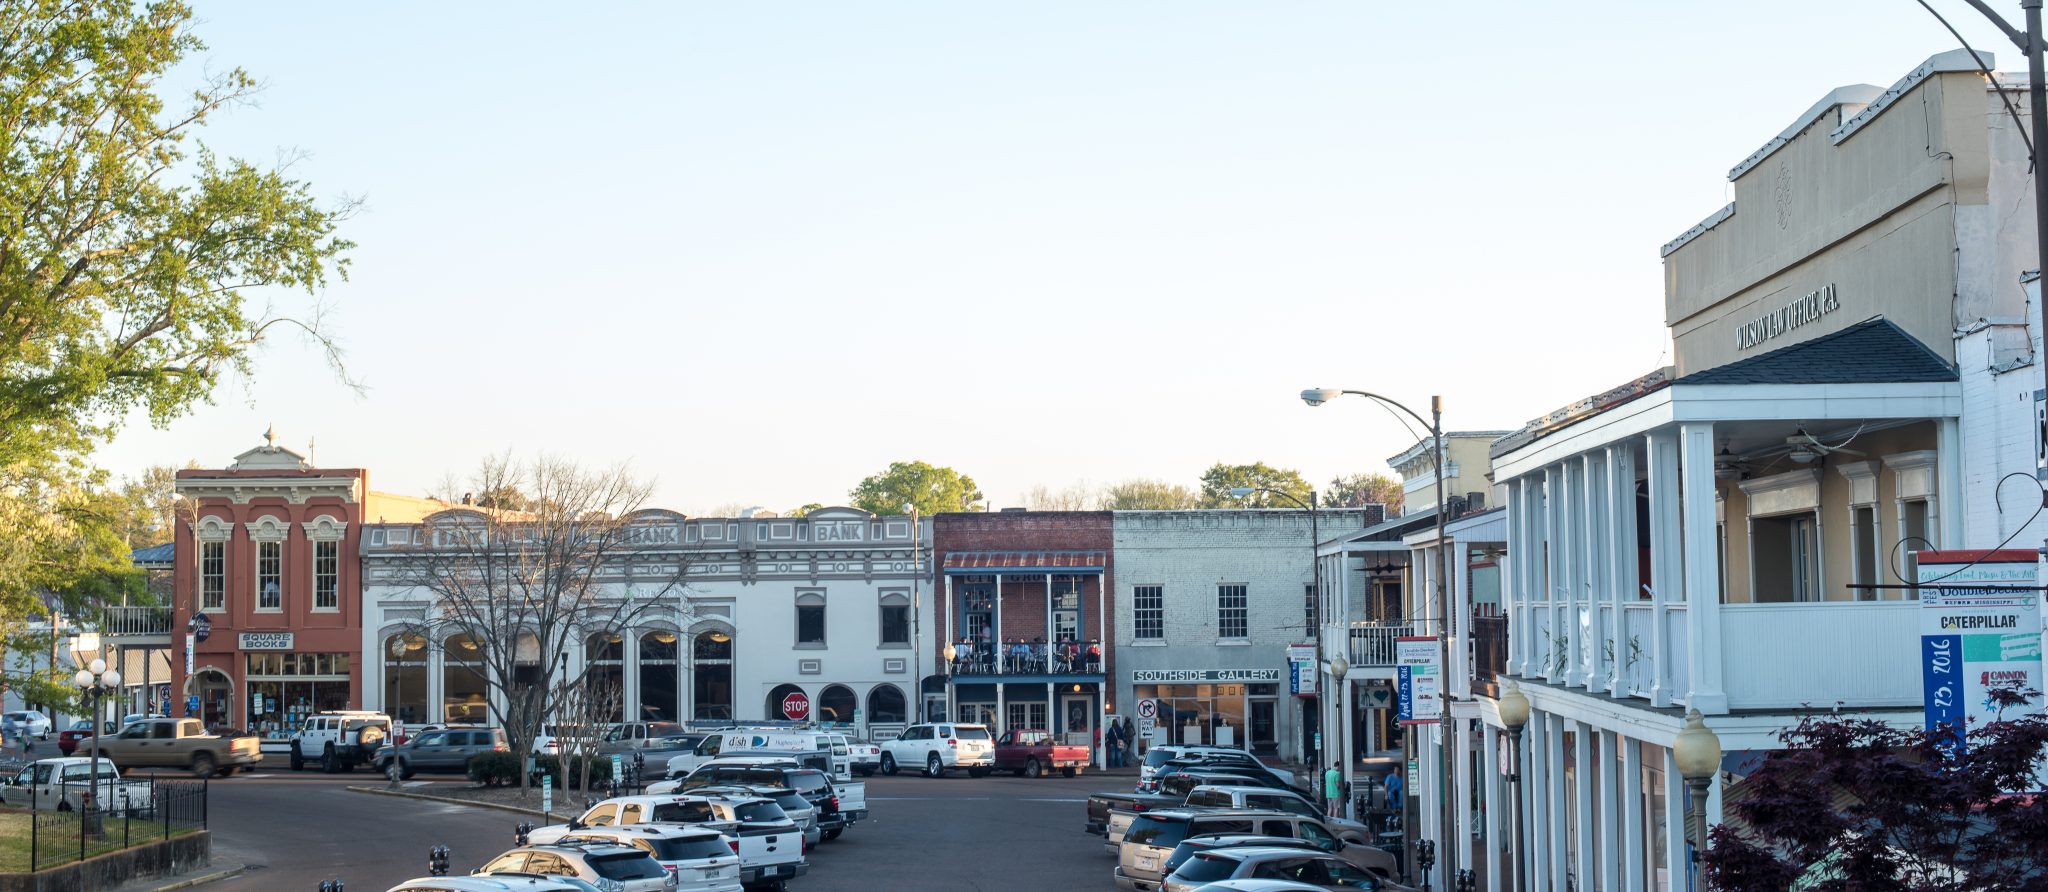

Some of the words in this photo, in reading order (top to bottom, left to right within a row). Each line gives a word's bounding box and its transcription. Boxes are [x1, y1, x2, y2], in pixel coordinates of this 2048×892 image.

[1736, 315, 1768, 351] WILSON
[1768, 306, 1788, 338] LAW
[632, 527, 675, 543] BANK
[817, 525, 861, 541] BANK
[1941, 615, 2017, 629] CATERPILLAR
[1930, 639, 1951, 674] 2016
[1136, 671, 1207, 681] SOUTHSIDE
[1217, 670, 1276, 680] GALLERY
[1990, 671, 2028, 680] CANNON
[785, 701, 808, 712] STOP
[729, 736, 747, 747] dish
